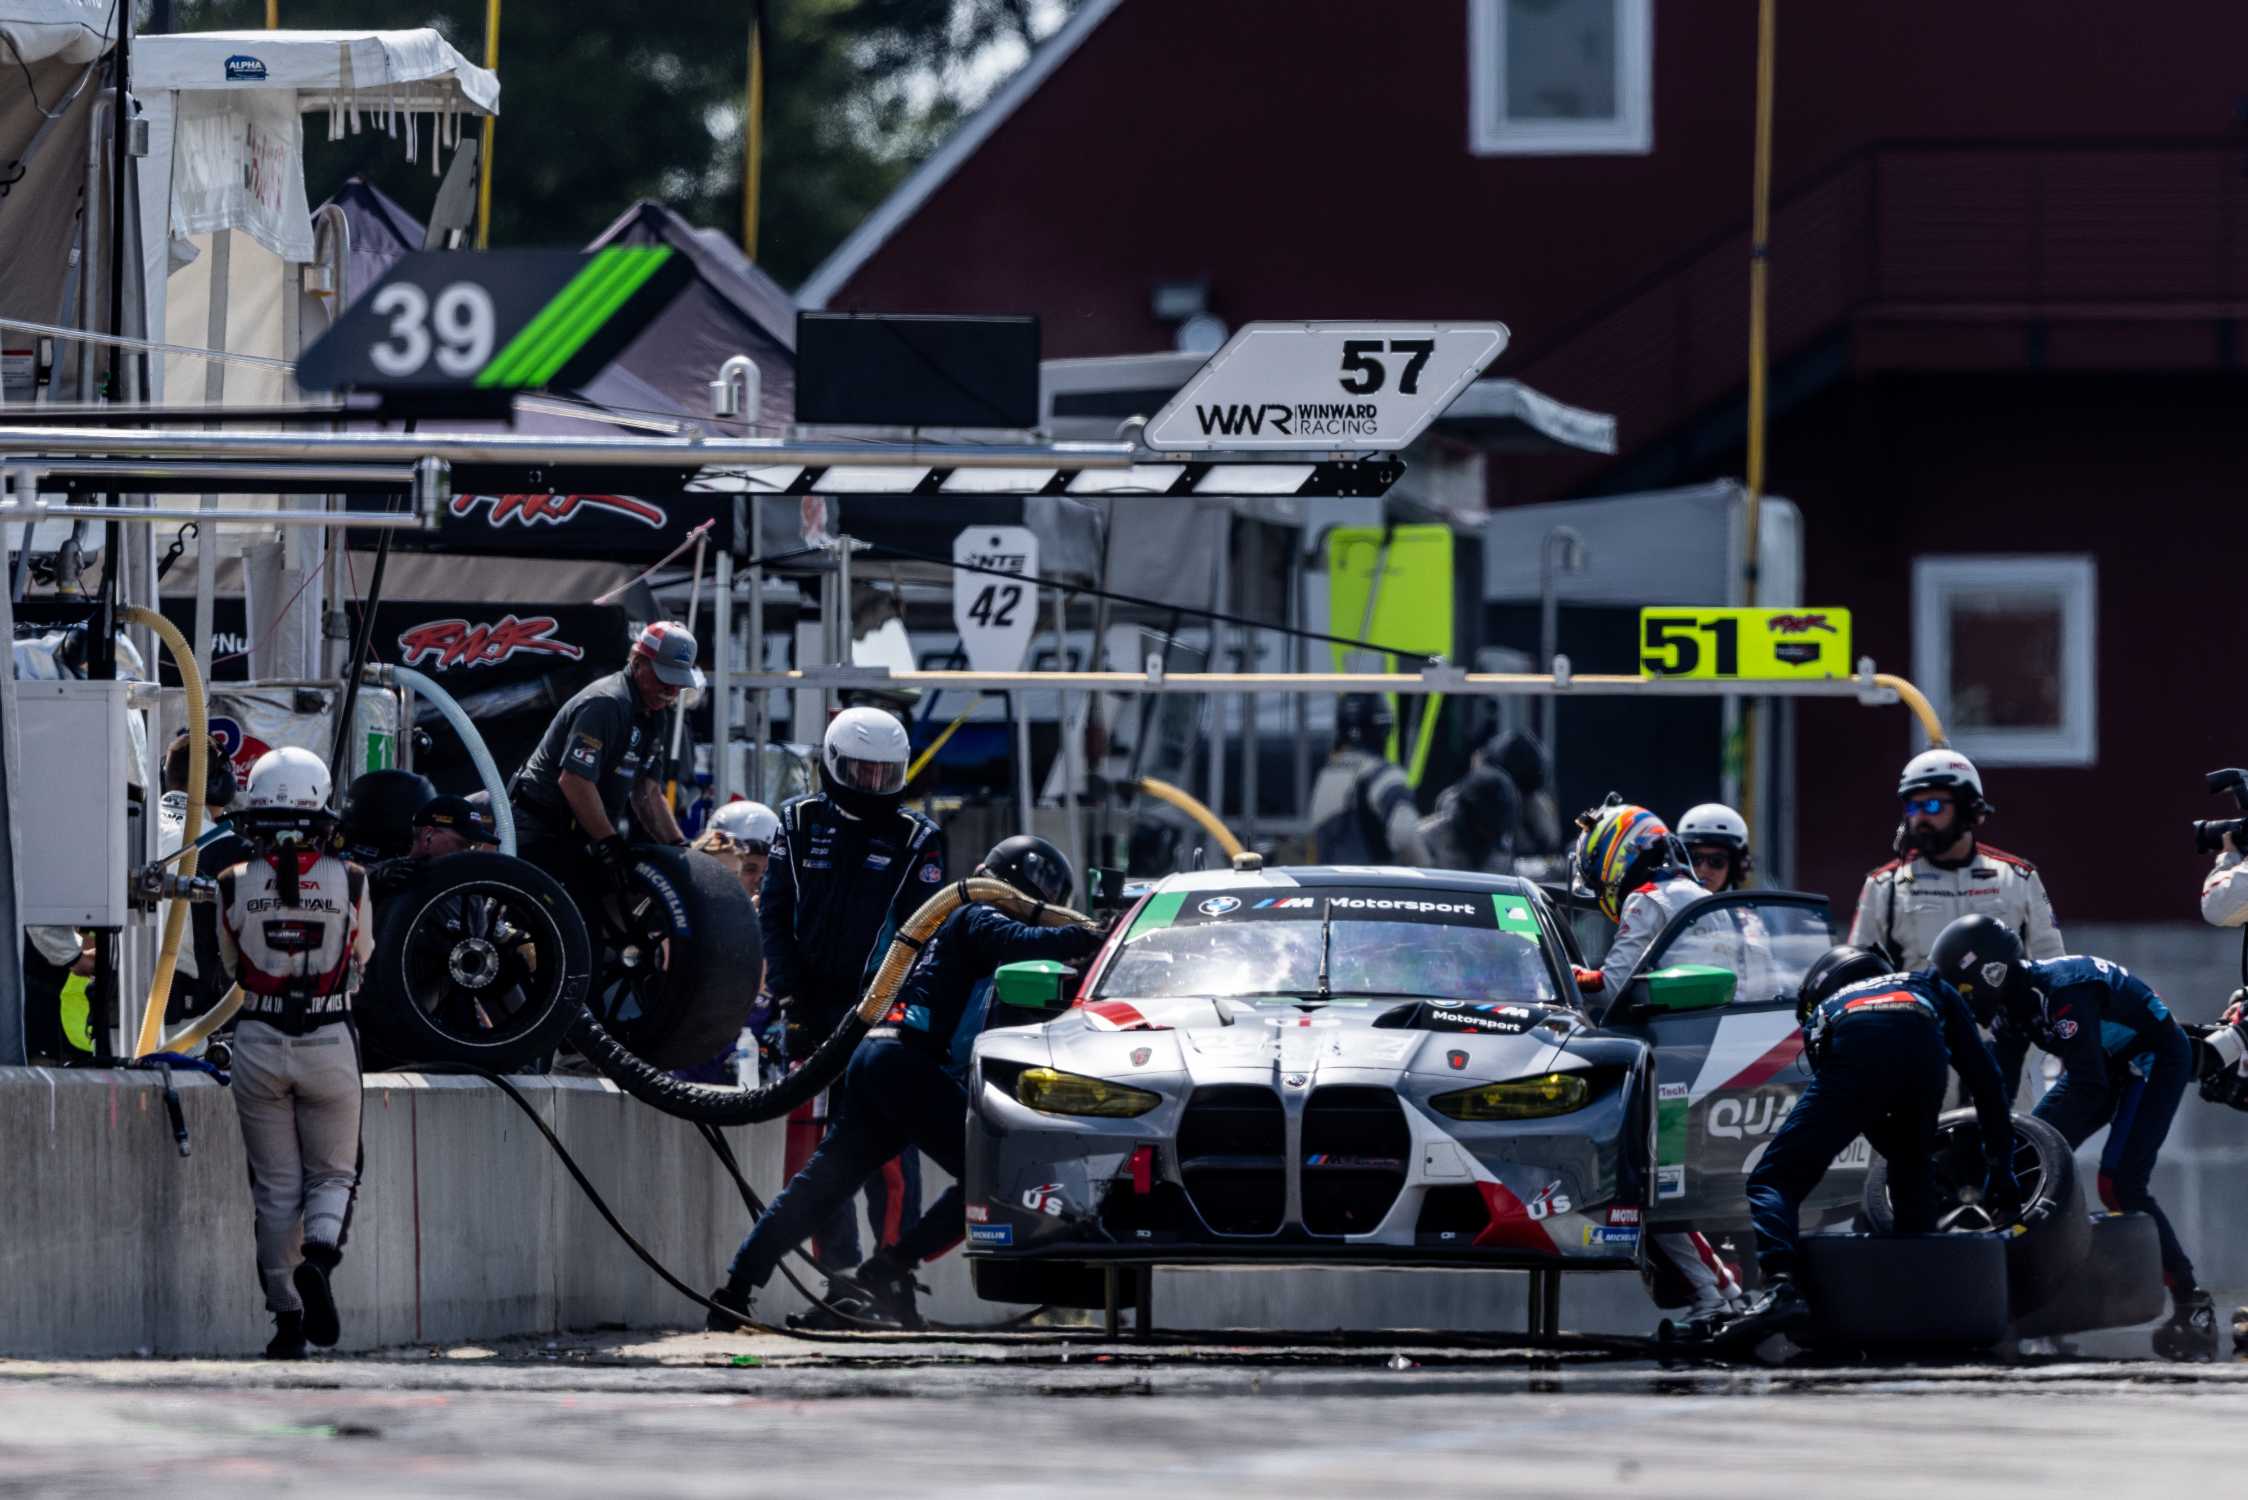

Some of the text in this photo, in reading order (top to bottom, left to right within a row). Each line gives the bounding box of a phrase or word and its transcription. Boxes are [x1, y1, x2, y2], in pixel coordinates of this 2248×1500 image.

[229, 61, 262, 69] ALPHA
[370, 281, 496, 377] 39
[1339, 340, 1434, 395] 57
[1298, 404, 1377, 419] WINWARD
[1300, 419, 1378, 435] RACING
[967, 585, 1022, 626] 42
[1643, 618, 1738, 676] 51
[635, 862, 687, 928] MICHELIN
[1329, 897, 1476, 916] Motorsport
[1432, 1010, 1521, 1032] Motorsport
